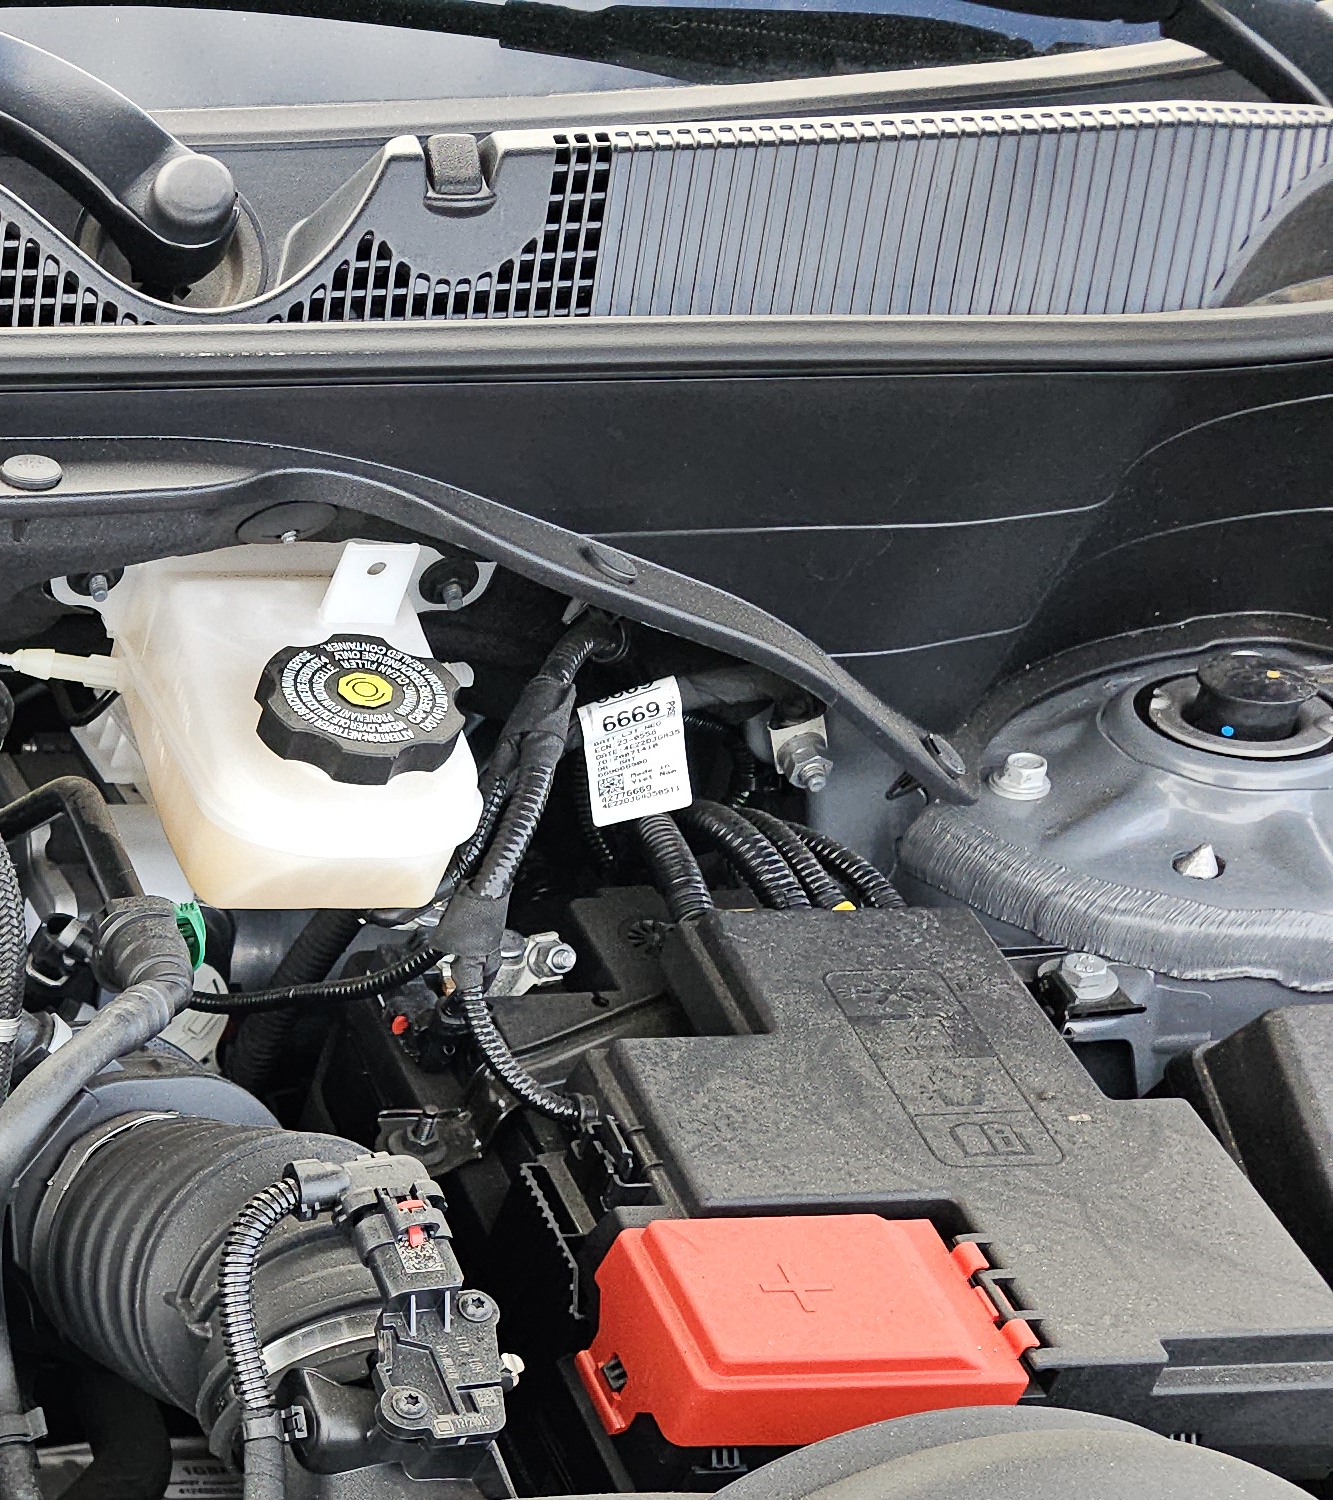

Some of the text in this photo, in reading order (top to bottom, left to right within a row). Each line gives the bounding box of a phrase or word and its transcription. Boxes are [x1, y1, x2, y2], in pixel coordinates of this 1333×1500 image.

[329, 650, 360, 660] ONLY
[361, 651, 383, 662] USE
[385, 649, 427, 671] SEALED
[338, 659, 377, 671] FILLER
[375, 664, 412, 685] CLEAN
[603, 702, 660, 732] 6669
